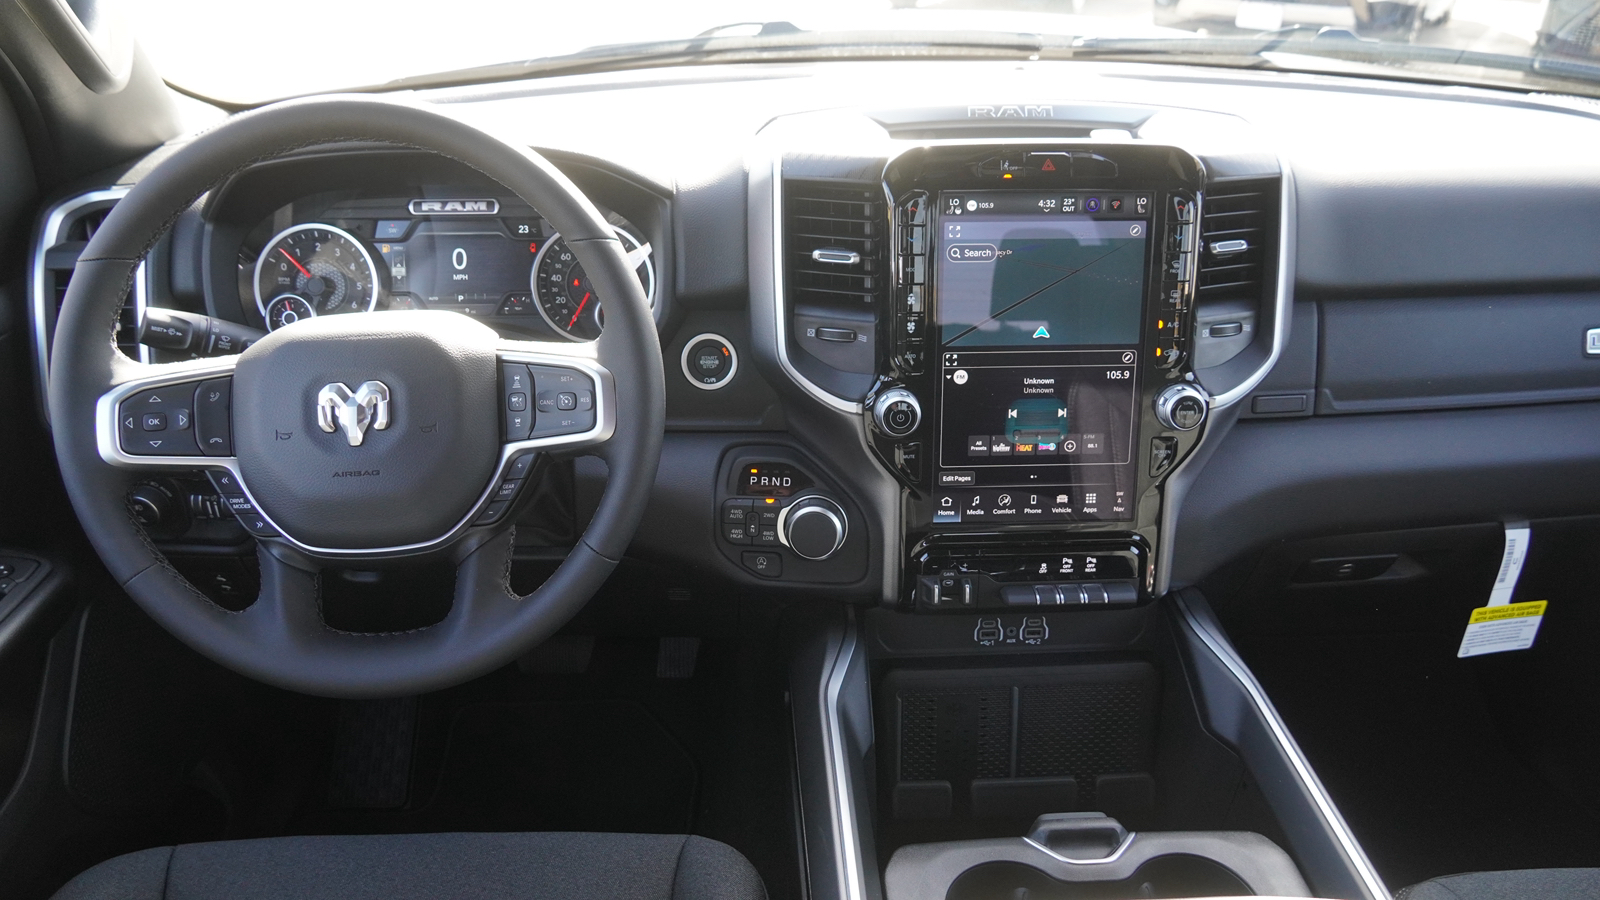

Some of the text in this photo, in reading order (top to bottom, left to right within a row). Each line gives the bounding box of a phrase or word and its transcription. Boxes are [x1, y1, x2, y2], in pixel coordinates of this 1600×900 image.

[968, 105, 1054, 118] RAM
[421, 202, 488, 212] RAM
[1038, 200, 1056, 208] 4:32
[518, 225, 530, 234] 23
[316, 242, 322, 251] 2
[334, 248, 341, 256] 3
[964, 249, 992, 257] Search
[452, 248, 468, 270] 0
[280, 262, 288, 271] 0
[350, 262, 356, 271] 4
[1106, 370, 1130, 379] 105.9
[332, 470, 380, 478] AIRBAG
